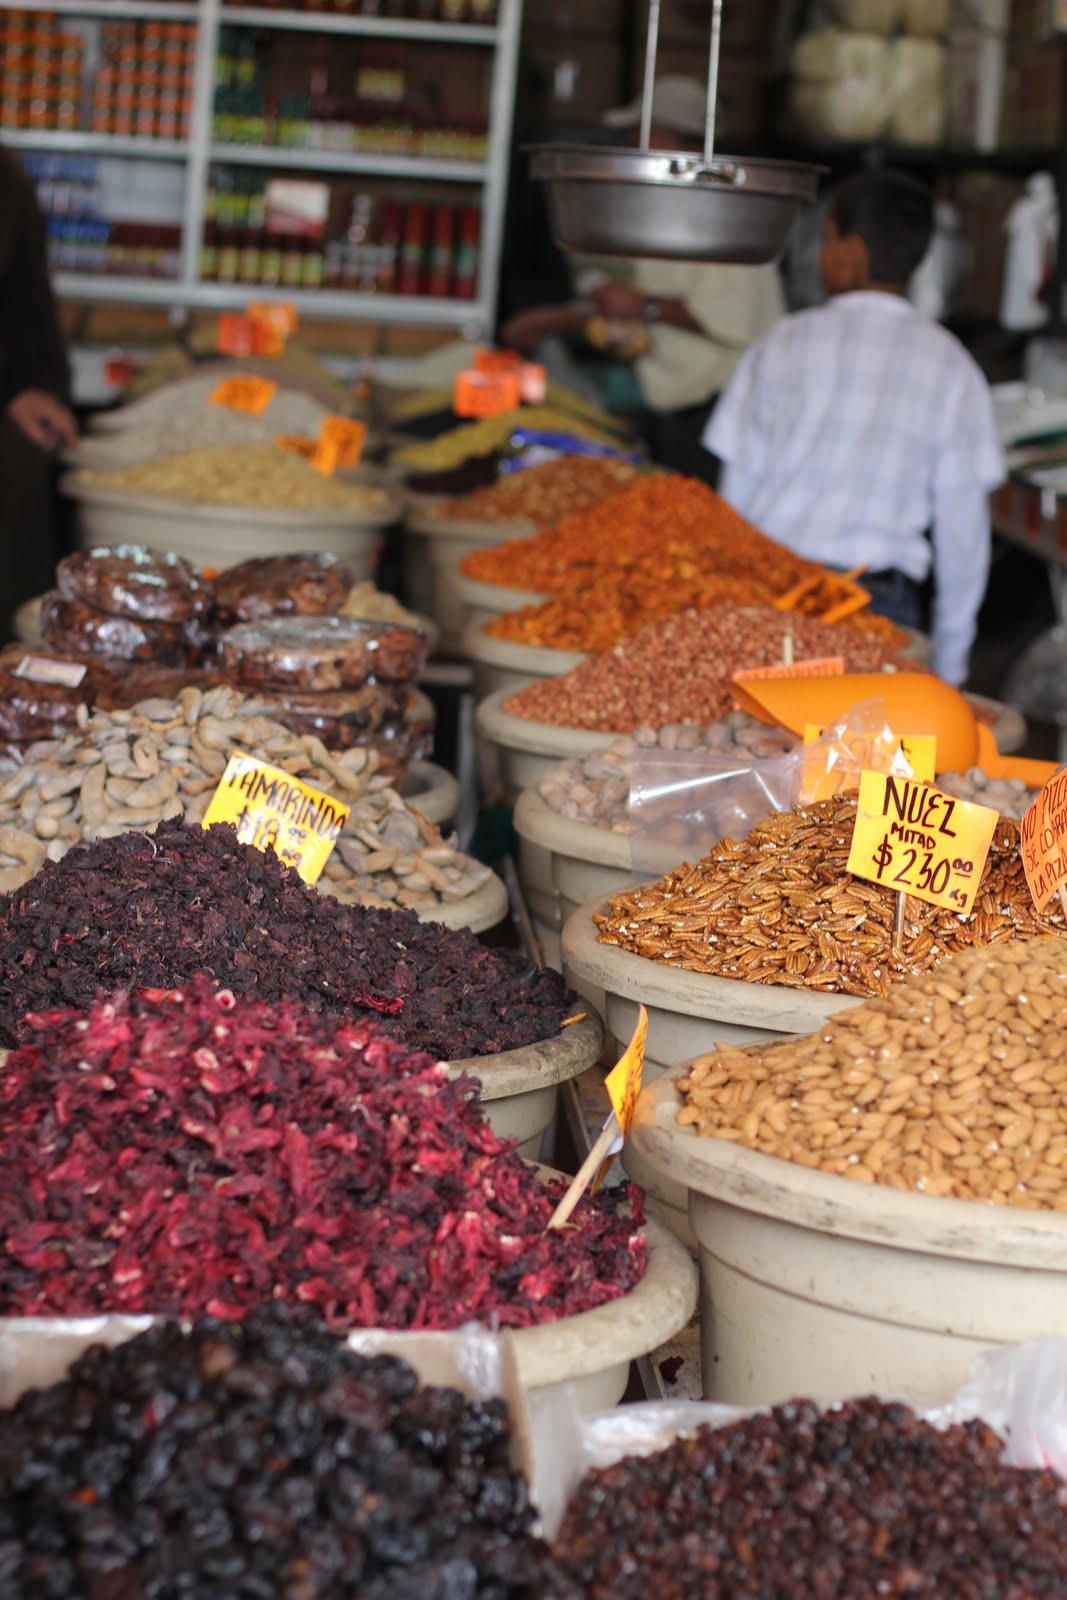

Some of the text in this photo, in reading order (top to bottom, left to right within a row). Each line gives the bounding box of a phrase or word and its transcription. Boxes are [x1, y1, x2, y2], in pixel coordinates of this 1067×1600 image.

[882, 776, 957, 838] NUEZ
[890, 821, 936, 850] MITAD
[1021, 805, 1037, 846] NO
[1025, 843, 1039, 872] SE
[1033, 874, 1049, 899] LA
